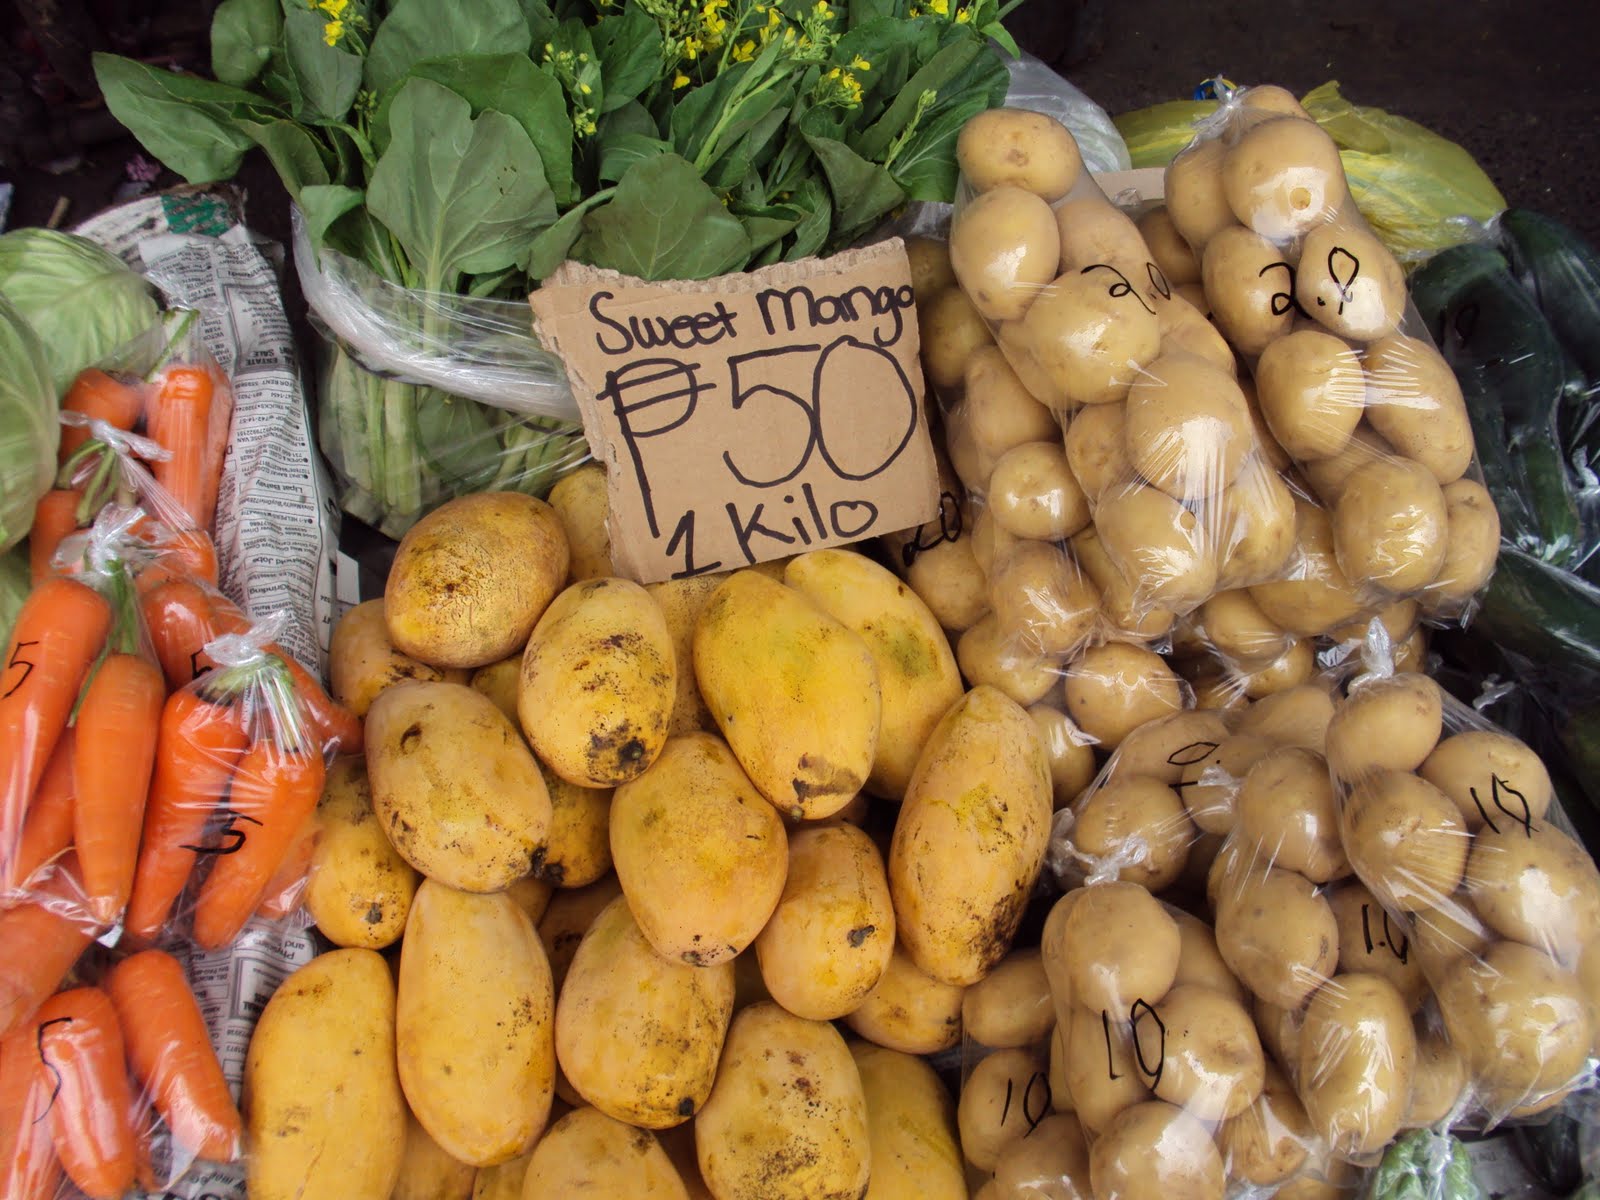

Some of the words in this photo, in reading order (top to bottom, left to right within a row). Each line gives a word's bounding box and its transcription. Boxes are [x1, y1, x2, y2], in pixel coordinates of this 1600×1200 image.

[589, 291, 738, 355] Sweet
[666, 510, 721, 579] 1
[726, 483, 878, 565] Kilo
[4, 641, 39, 699] 5
[180, 810, 263, 854] 5
[32, 1016, 73, 1124] 5
[1102, 998, 1166, 1091] 10
[1001, 1071, 1052, 1139] 10
